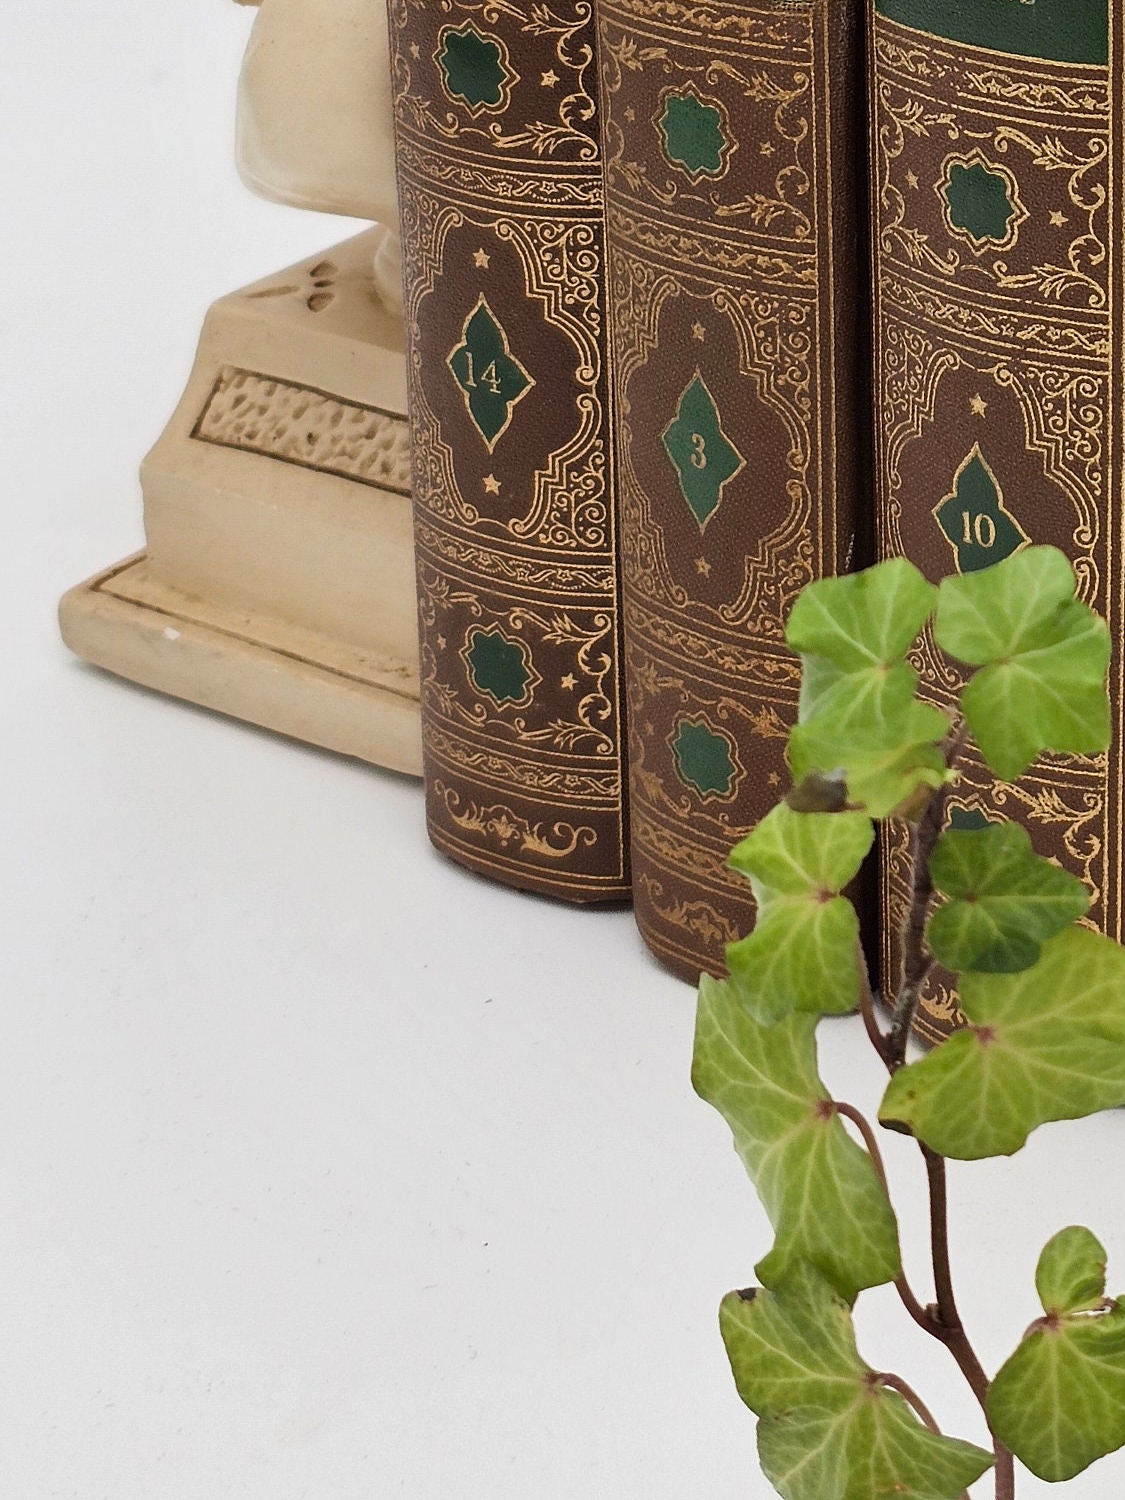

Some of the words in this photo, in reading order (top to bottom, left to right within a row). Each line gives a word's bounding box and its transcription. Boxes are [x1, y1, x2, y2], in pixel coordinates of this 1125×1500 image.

[465, 351, 501, 394] 14
[690, 433, 707, 470] 3
[961, 510, 996, 548] 10
